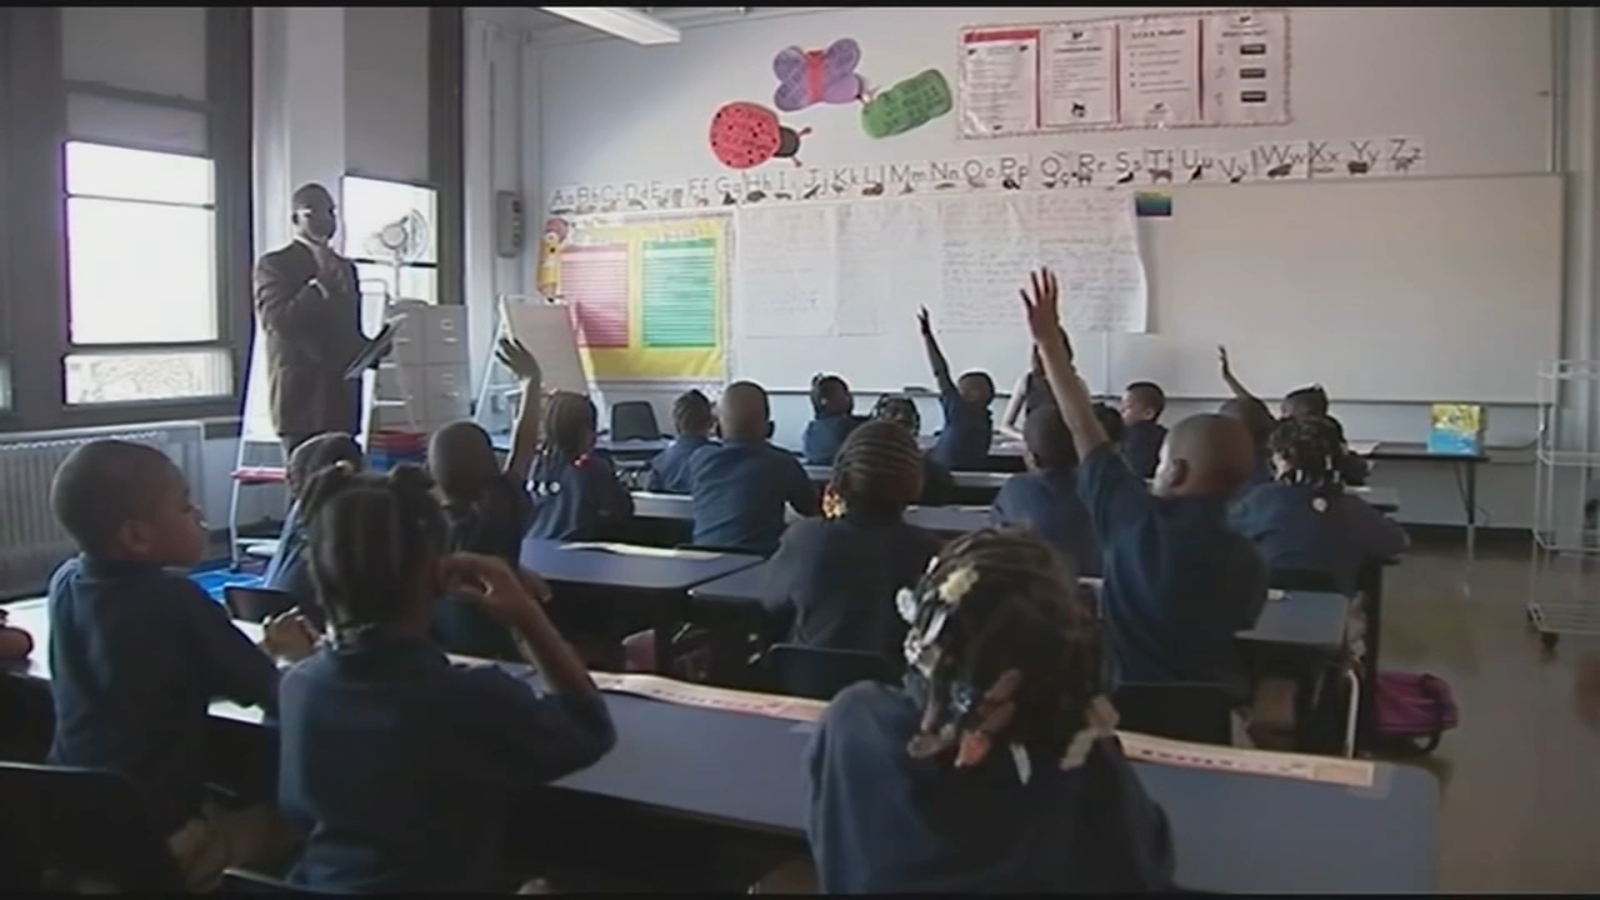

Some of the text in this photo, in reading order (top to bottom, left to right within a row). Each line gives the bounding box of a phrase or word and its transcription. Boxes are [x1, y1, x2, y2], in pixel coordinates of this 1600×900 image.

[804, 168, 829, 196] Jj
[834, 167, 858, 187] Kk
[891, 163, 926, 181] Mm
[931, 162, 959, 181] Nn
[963, 159, 996, 180] Oo
[1001, 157, 1029, 184] Pp
[1078, 153, 1107, 173] Rr
[1114, 151, 1143, 173] Ss
[1182, 149, 1213, 170] Uu
[1258, 144, 1306, 165] Ww
[1308, 140, 1340, 164] Xx
[1348, 139, 1381, 171] Yy
[1389, 138, 1422, 161] Zz
